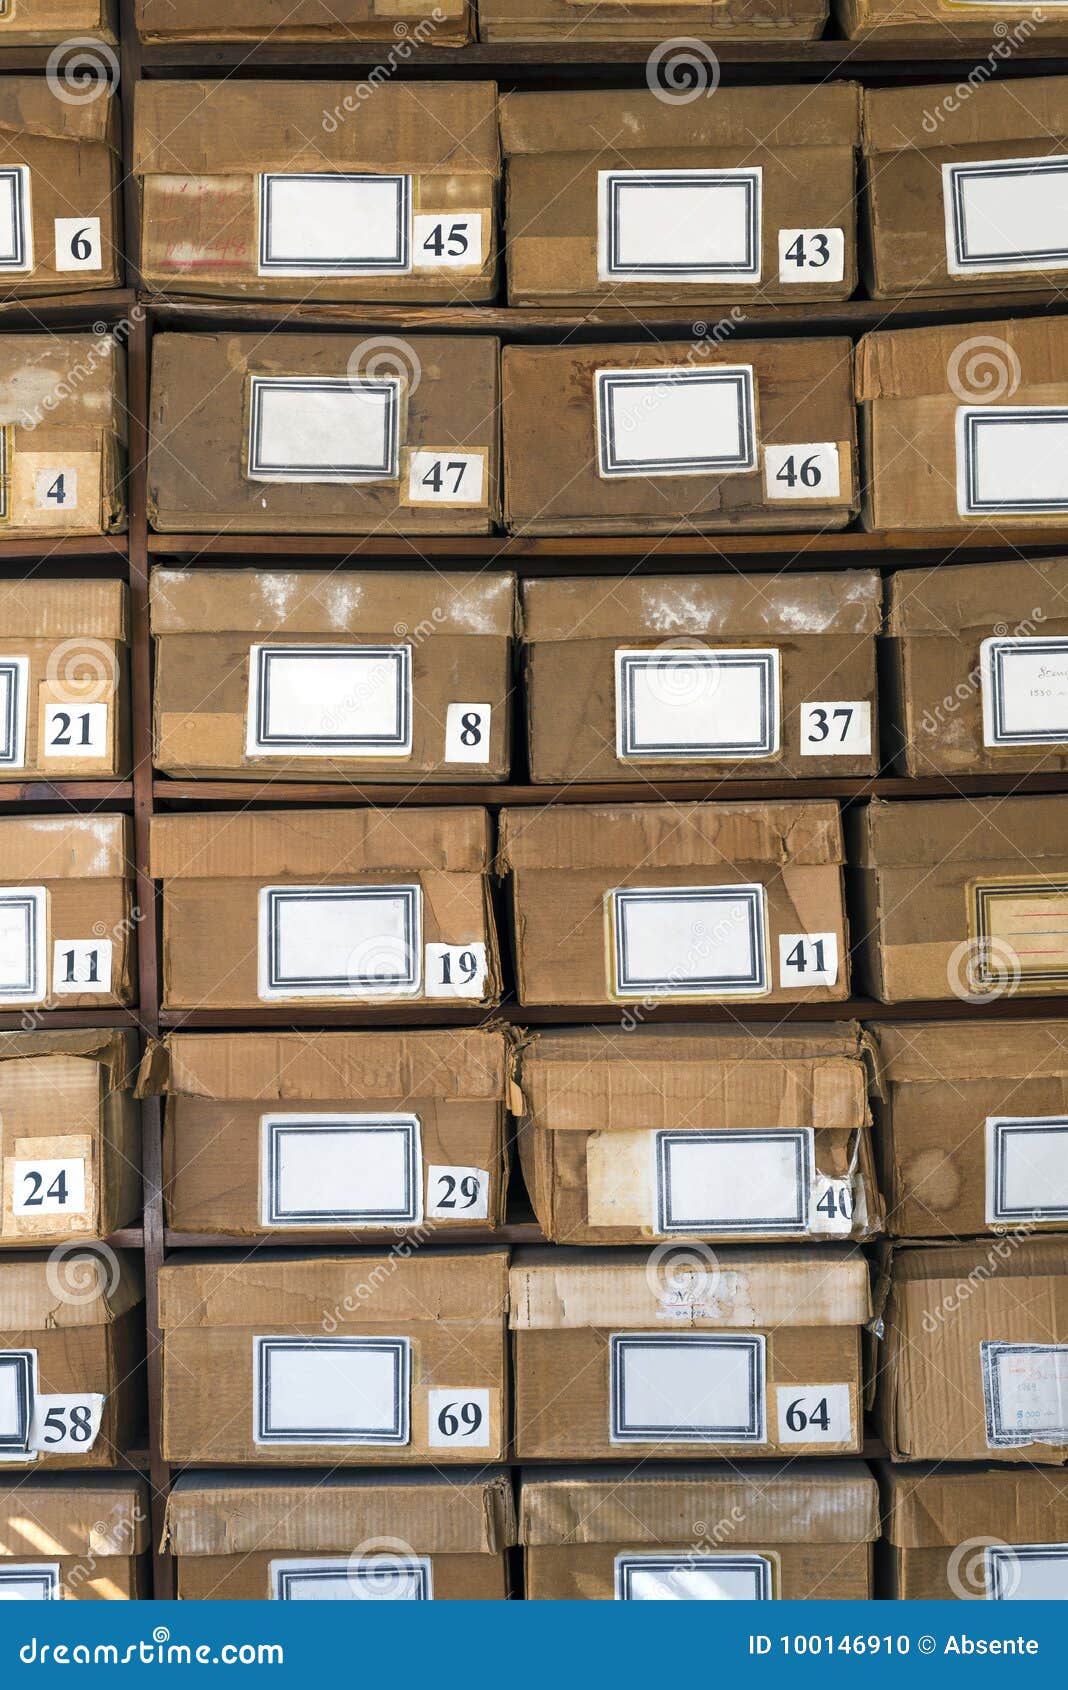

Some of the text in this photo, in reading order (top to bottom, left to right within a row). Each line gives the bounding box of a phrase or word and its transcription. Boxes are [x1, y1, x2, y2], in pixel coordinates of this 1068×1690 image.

[70, 227, 92, 260] 6
[423, 223, 468, 257] 45
[785, 233, 830, 268] 43
[422, 461, 468, 493] 47
[776, 454, 822, 487] 46
[45, 472, 67, 504] 4
[50, 712, 91, 745] 21
[460, 712, 482, 746] 8
[808, 708, 854, 742] 37
[63, 949, 99, 982] 11
[440, 951, 477, 985] 19
[786, 939, 827, 972] 41
[23, 1169, 69, 1206] 24
[436, 1175, 478, 1209] 29
[815, 1184, 857, 1221] 40
[43, 1405, 93, 1444] 58
[438, 1402, 482, 1437] 69
[785, 1397, 831, 1432] 64
